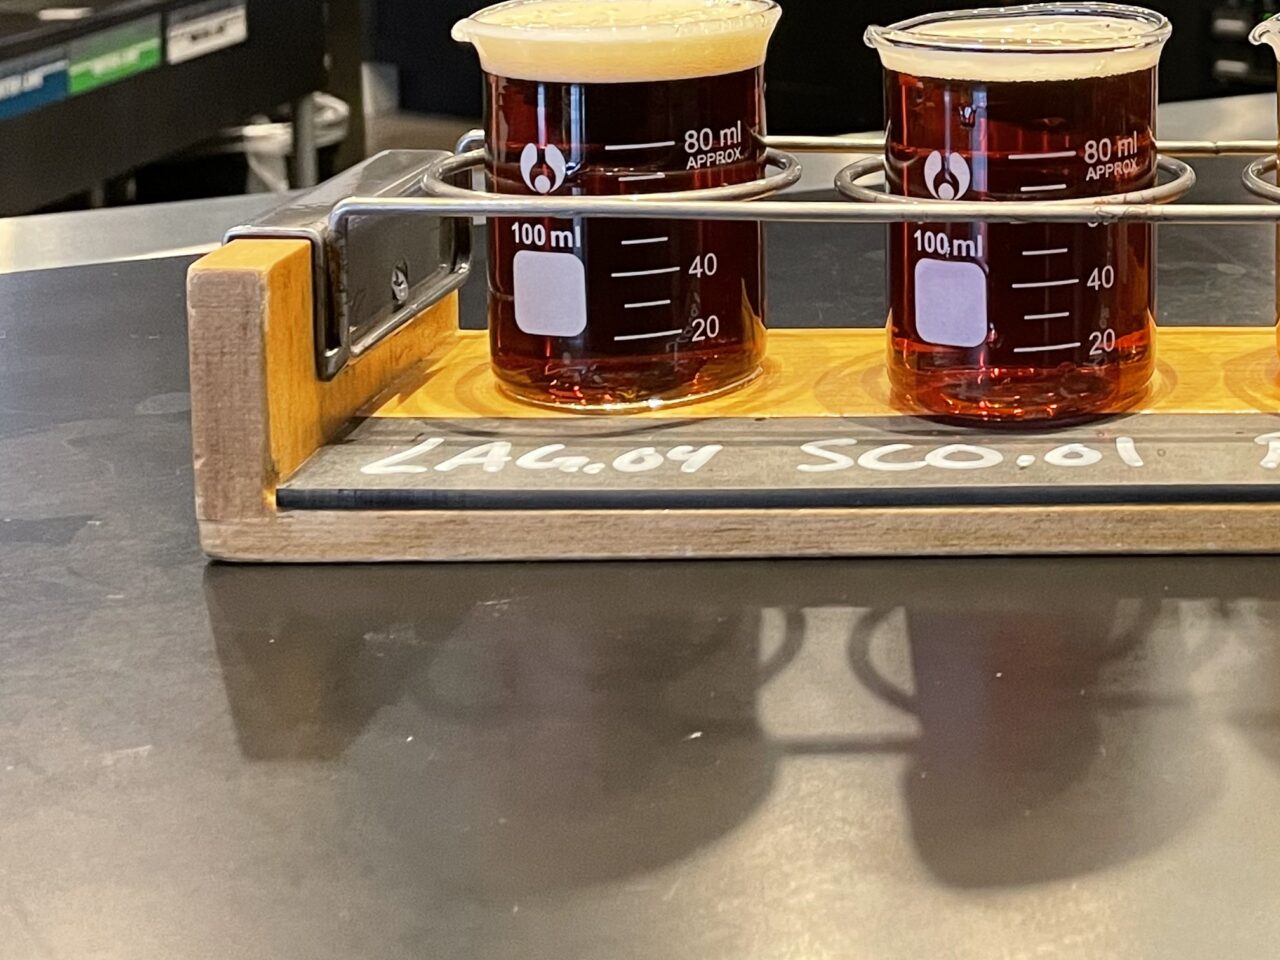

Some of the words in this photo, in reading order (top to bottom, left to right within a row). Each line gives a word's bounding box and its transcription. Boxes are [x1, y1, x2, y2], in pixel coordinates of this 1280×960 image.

[684, 127, 713, 153] 80
[720, 120, 741, 147] ml
[1084, 137, 1112, 164] 80
[1117, 130, 1137, 158] ml
[511, 221, 546, 246] 100
[550, 225, 581, 247] ml
[913, 229, 950, 255] 100
[952, 234, 983, 257] ml
[688, 252, 718, 278] 40
[1086, 264, 1115, 291] 40
[691, 315, 720, 342] 20
[1088, 328, 1116, 356] 20
[796, 437, 1145, 472] SCO.01
